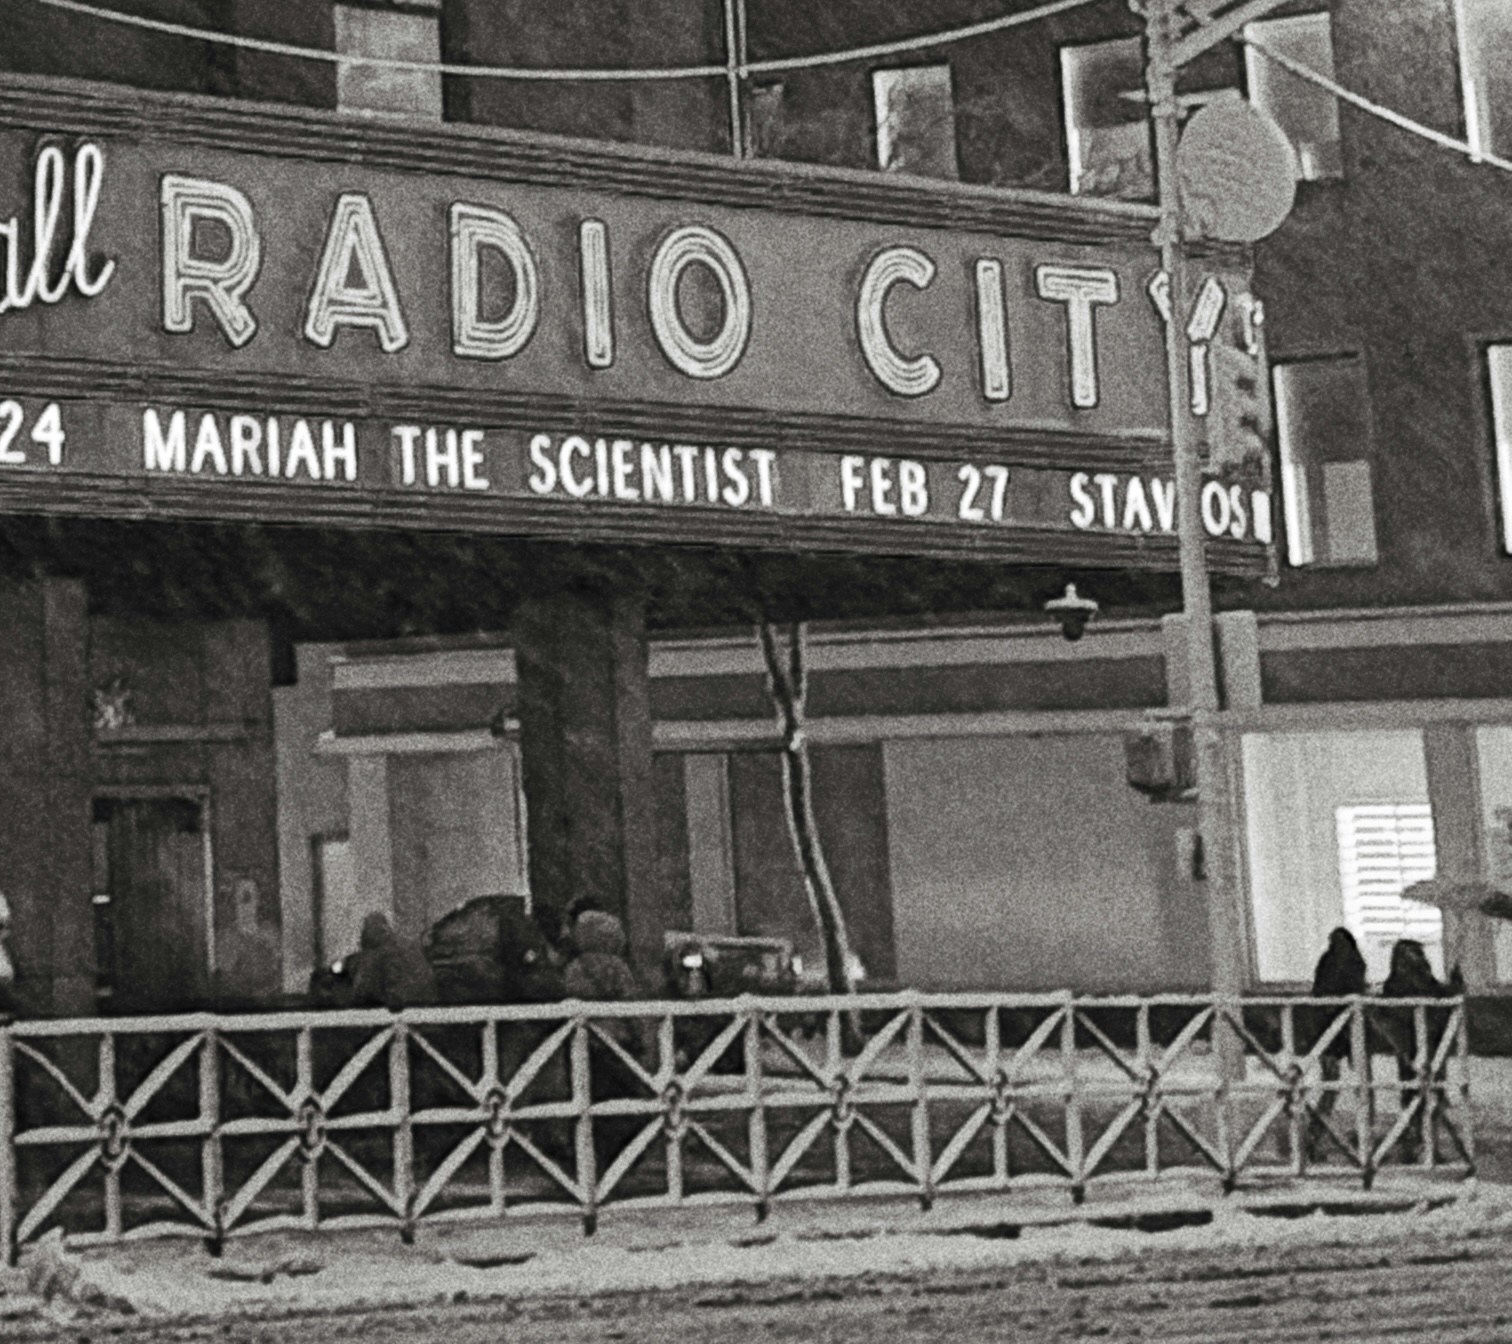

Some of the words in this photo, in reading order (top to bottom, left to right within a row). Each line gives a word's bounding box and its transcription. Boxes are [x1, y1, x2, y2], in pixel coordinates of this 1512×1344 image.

[161, 173, 752, 381] RADIO
[856, 244, 1227, 416] CITY
[143, 409, 357, 481] MARIAH
[393, 425, 489, 490] THE
[529, 434, 775, 507] SCIENTIST
[841, 456, 928, 518] FEB
[958, 464, 1009, 522] 27
[1070, 470, 1247, 541] STAVOS
